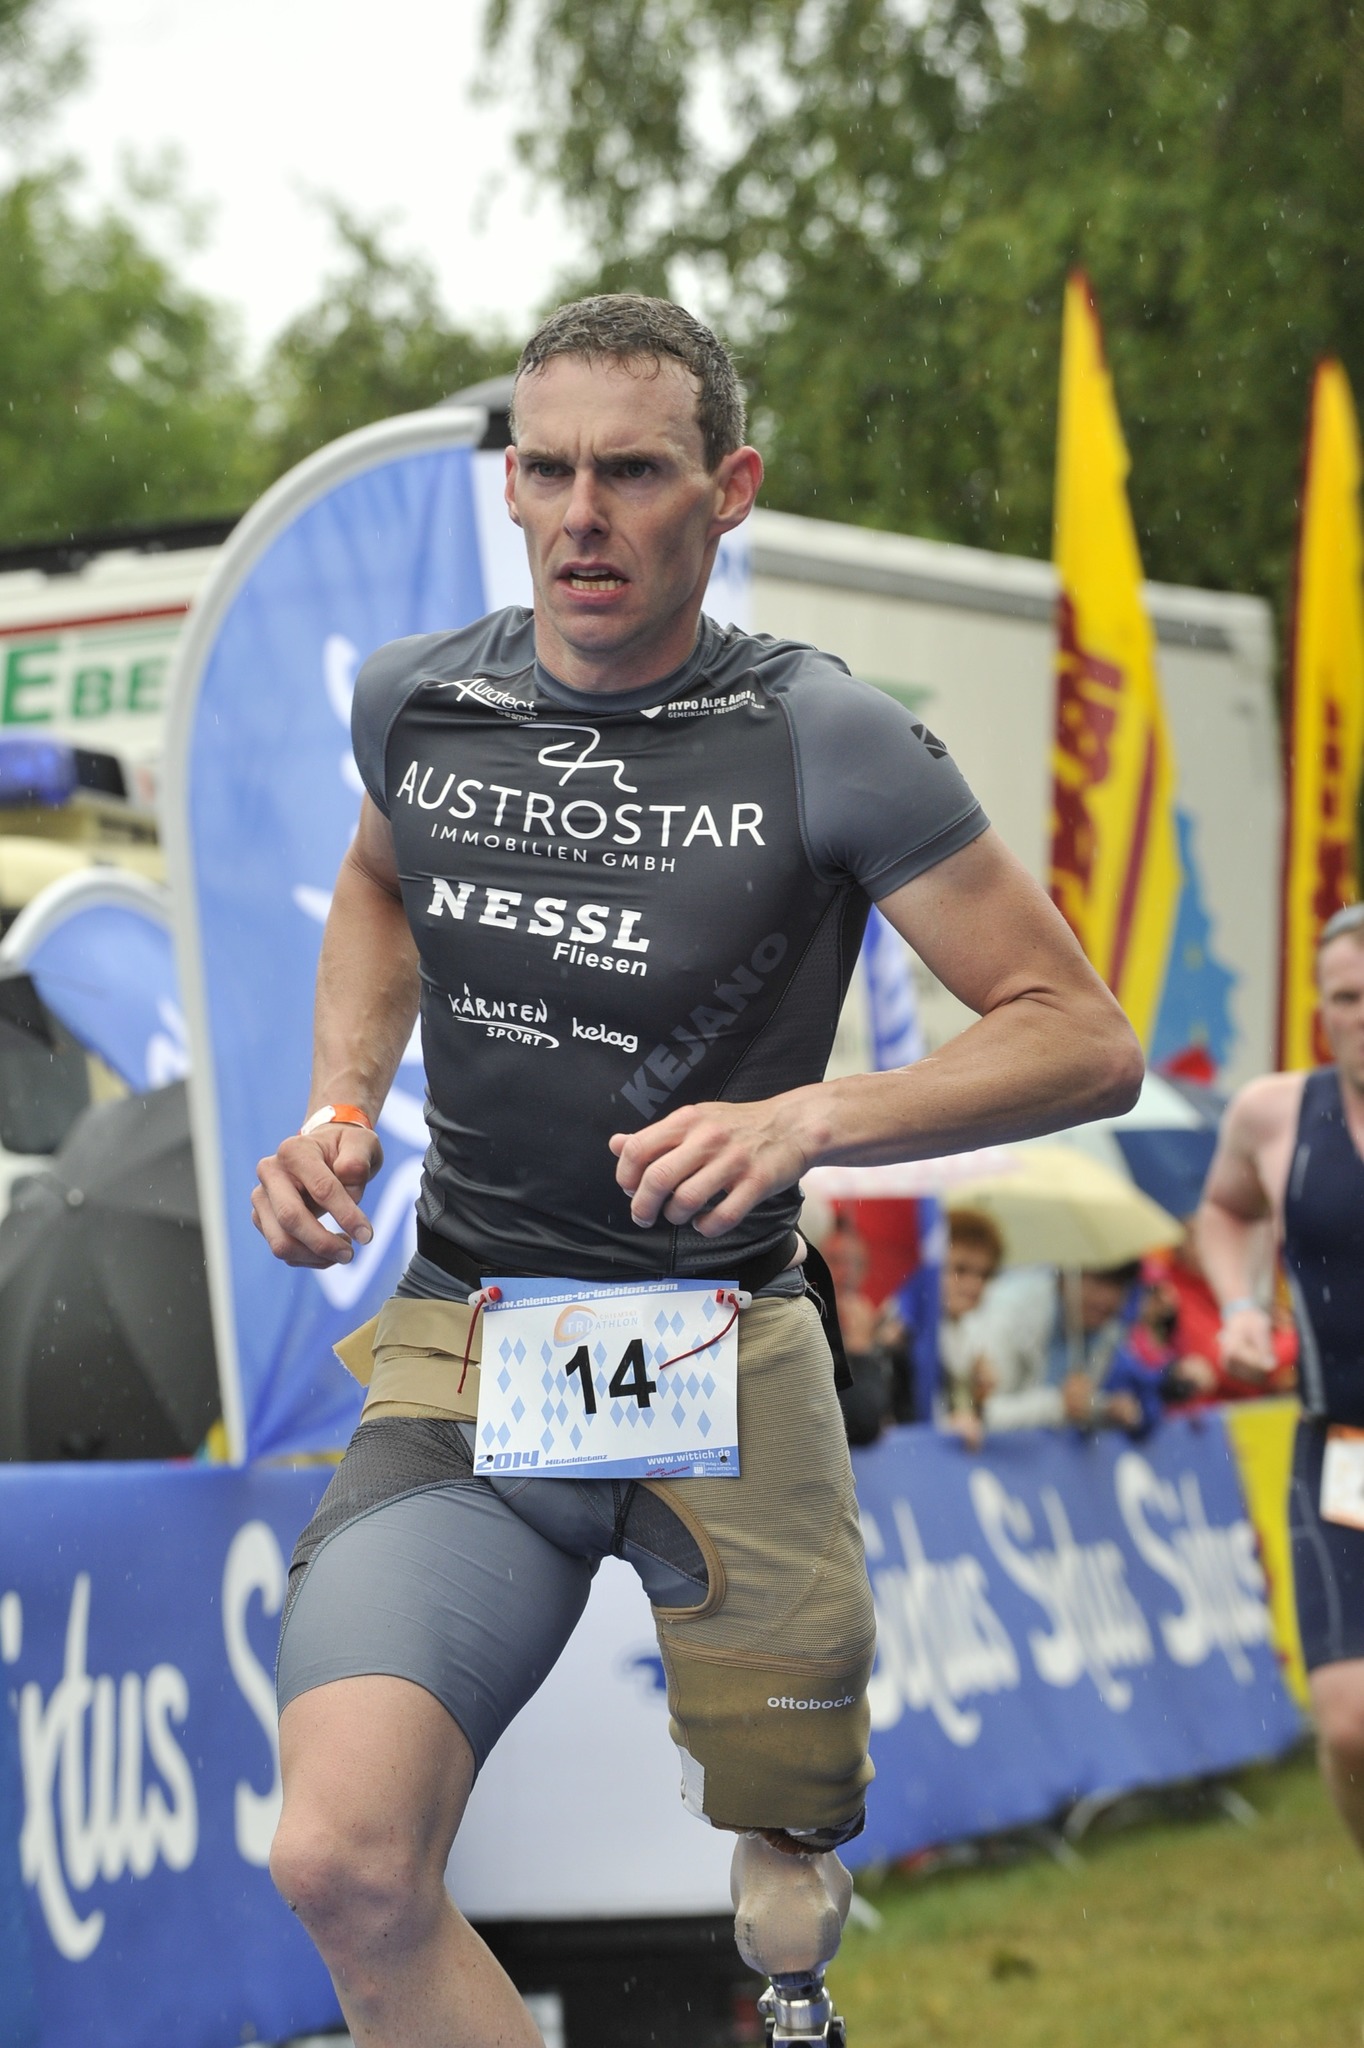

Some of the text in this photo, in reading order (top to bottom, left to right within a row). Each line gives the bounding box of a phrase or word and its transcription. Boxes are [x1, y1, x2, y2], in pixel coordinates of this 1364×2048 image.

[438, 678, 538, 712] Auratect
[668, 690, 756, 711] HYPO ALPE ADRIA
[668, 709, 710, 718] GEMEINSAM
[396, 760, 766, 848] AUSTROSTAR
[430, 823, 677, 873] IMMOBILIEN GMBH
[427, 877, 650, 953] NESSL
[552, 941, 648, 977] Fliesen
[486, 1026, 543, 1047] SPORT
[572, 1016, 639, 1054] kelag
[619, 932, 789, 1122] KEJANO
[564, 1338, 657, 1415] 14
[476, 1450, 540, 1471] 2014
[647, 1448, 731, 1466] www.wittich.de
